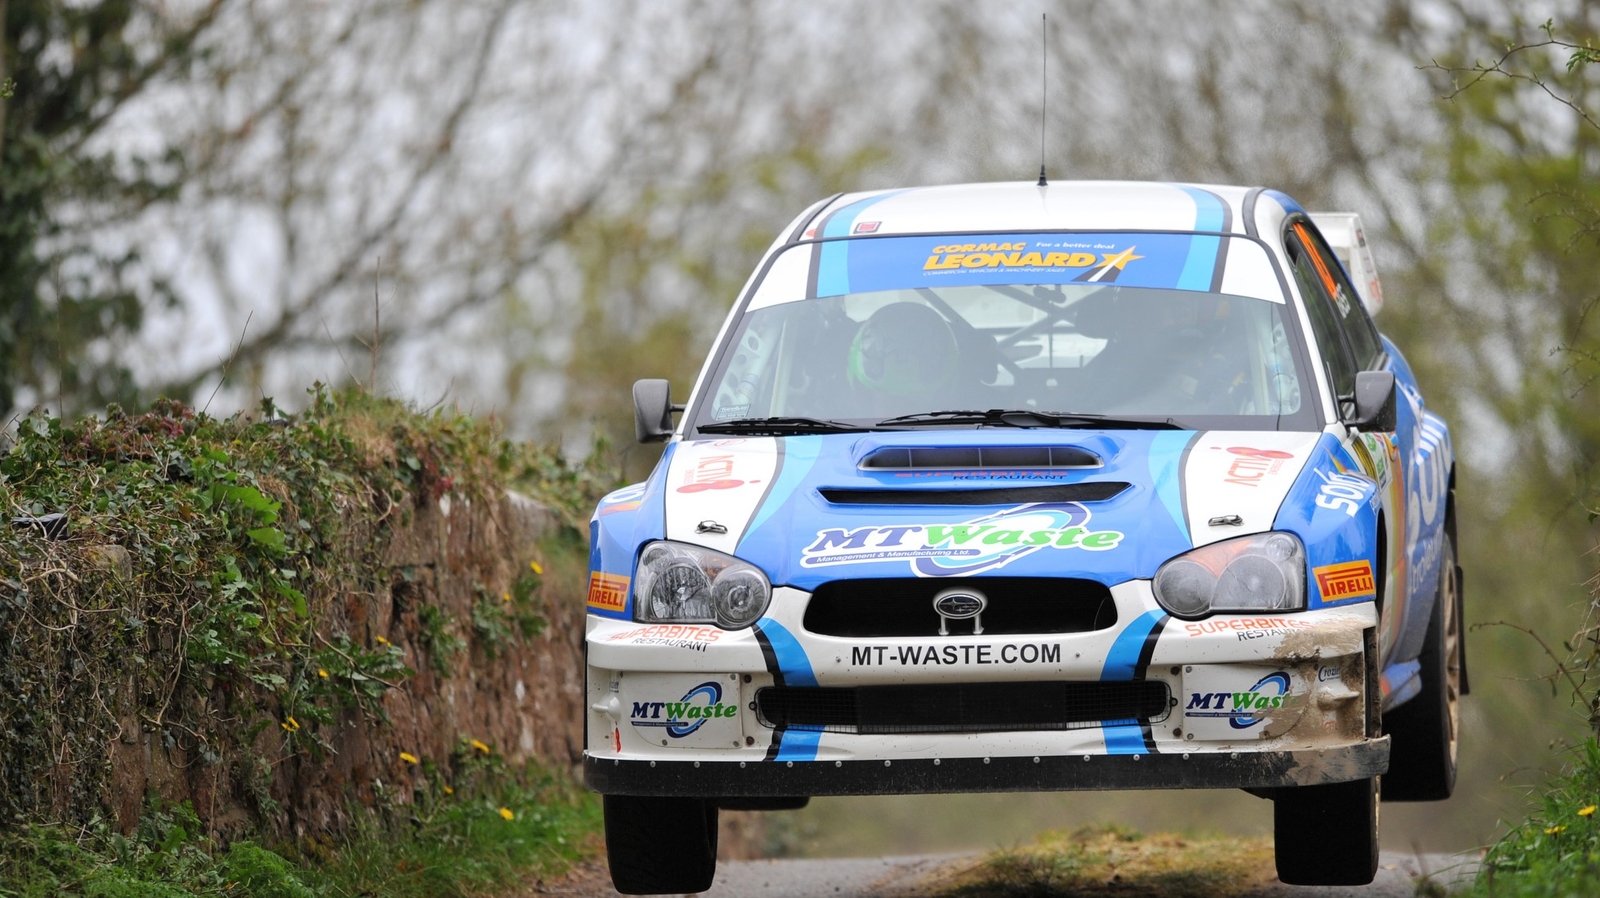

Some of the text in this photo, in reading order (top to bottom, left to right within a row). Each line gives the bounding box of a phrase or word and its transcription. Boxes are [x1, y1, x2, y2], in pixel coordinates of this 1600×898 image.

[932, 242, 1027, 254] CORMAC
[923, 252, 1098, 270] LEONARD
[816, 552, 876, 562] Management
[887, 549, 952, 558] Manufacturing
[1318, 566, 1374, 597] PIRELLI
[588, 578, 628, 607] PIRELLI
[607, 625, 724, 642] SUPERBITES
[1185, 618, 1317, 637] SUPERBITES
[631, 637, 711, 653] RESTAURANT
[852, 643, 1061, 666] MT-WASTE.COM
